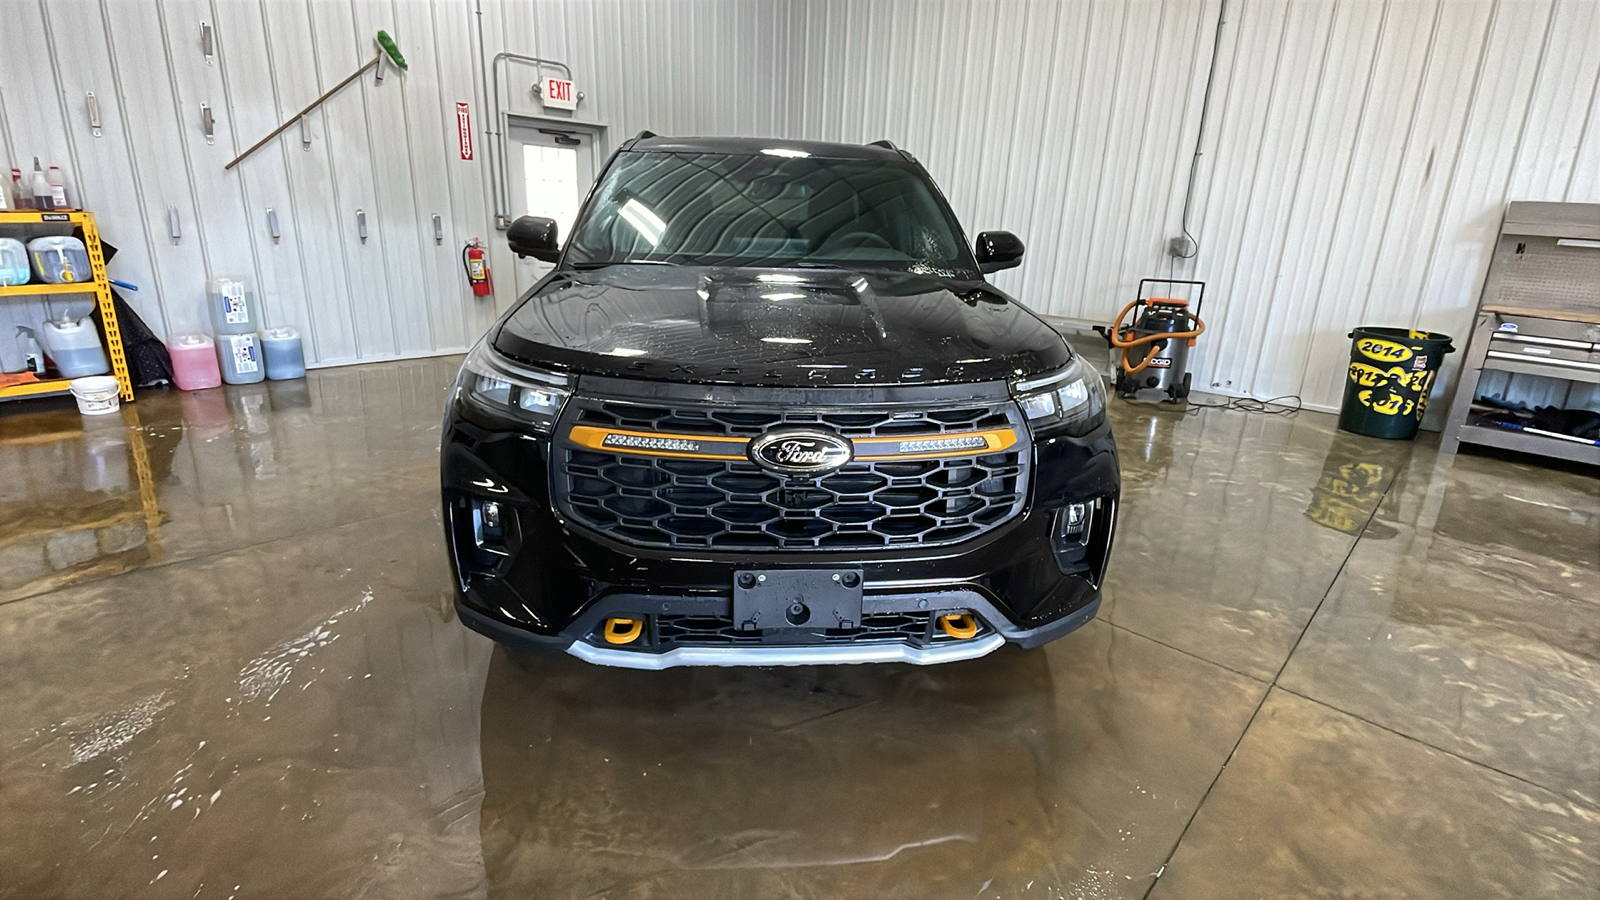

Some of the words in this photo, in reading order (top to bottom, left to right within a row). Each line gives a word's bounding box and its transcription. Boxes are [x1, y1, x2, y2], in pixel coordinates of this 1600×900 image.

[549, 79, 571, 101] EXIT
[1361, 341, 1405, 359] 2014
[776, 440, 827, 462] Ford
